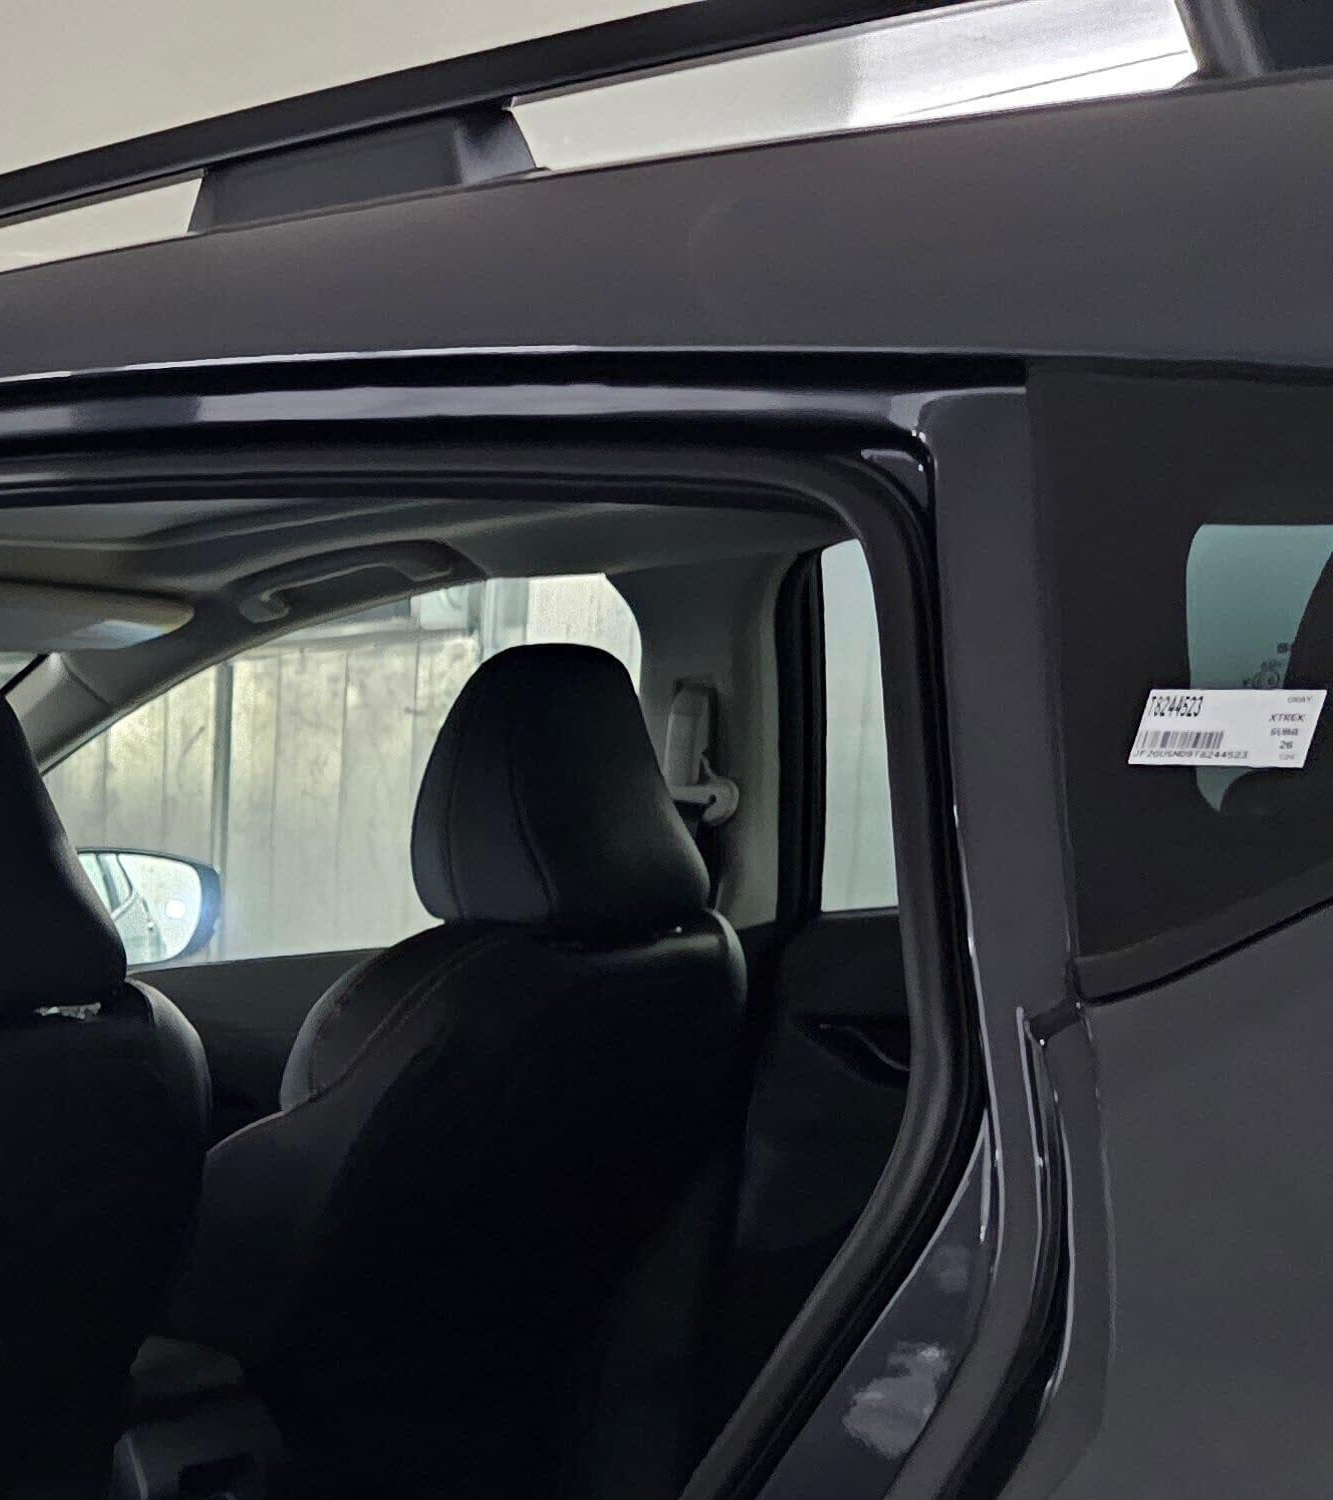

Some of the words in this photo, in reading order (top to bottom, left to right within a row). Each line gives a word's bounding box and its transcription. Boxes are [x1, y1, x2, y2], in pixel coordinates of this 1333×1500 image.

[1149, 696, 1203, 717] T8244523
[1269, 714, 1306, 722] XTREK
[1279, 740, 1293, 749] 26
